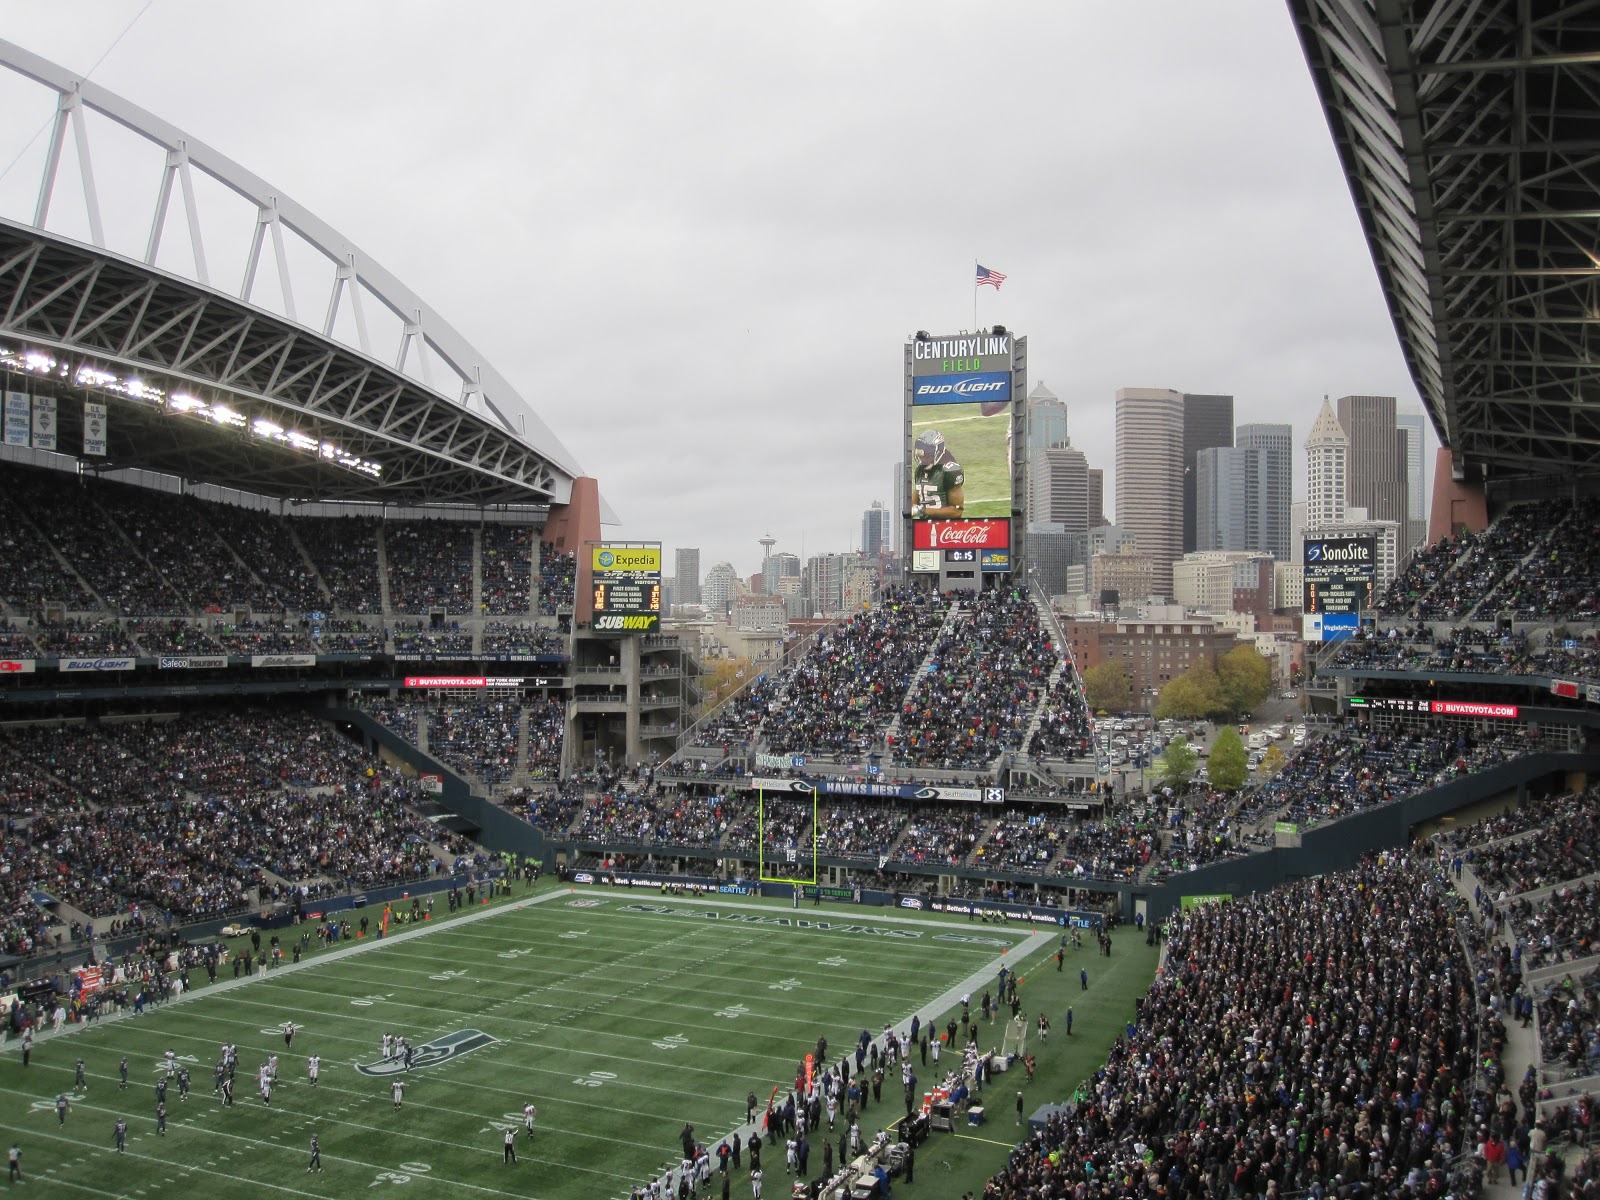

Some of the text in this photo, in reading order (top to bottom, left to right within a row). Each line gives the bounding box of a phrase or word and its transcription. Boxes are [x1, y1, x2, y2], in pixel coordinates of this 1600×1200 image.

[915, 336, 1009, 359] CENTURYLINK
[943, 358, 981, 372] FIELD
[917, 382, 1006, 395] BUD LIGHT
[33, 404, 46, 412] OPEN
[34, 432, 56, 441] CHAMPS
[85, 439, 106, 447] CHAMPS
[939, 525, 992, 544] Coca-Cola
[1322, 543, 1369, 560] SonoSite
[616, 555, 655, 567] Expedia
[595, 615, 657, 629] SUBWAY
[1565, 640, 1574, 649] 12
[0, 661, 22, 672] Clips
[67, 660, 129, 669] BUD LIGHT
[162, 657, 223, 668] Safeco Insurance
[1446, 704, 1514, 716] BUYATOYOTA.COM
[795, 758, 804, 767] 12
[869, 766, 878, 775] 12
[826, 782, 902, 796] HAWKS NEST
[787, 853, 796, 862] 12
[720, 886, 746, 894] SEATTLE
[831, 889, 852, 897] SERVICE
[616, 904, 924, 938] SEAHAWKS
[652, 1035, 689, 1049] 40
[572, 1071, 617, 1087] 50
[376, 1161, 432, 1184] 30
